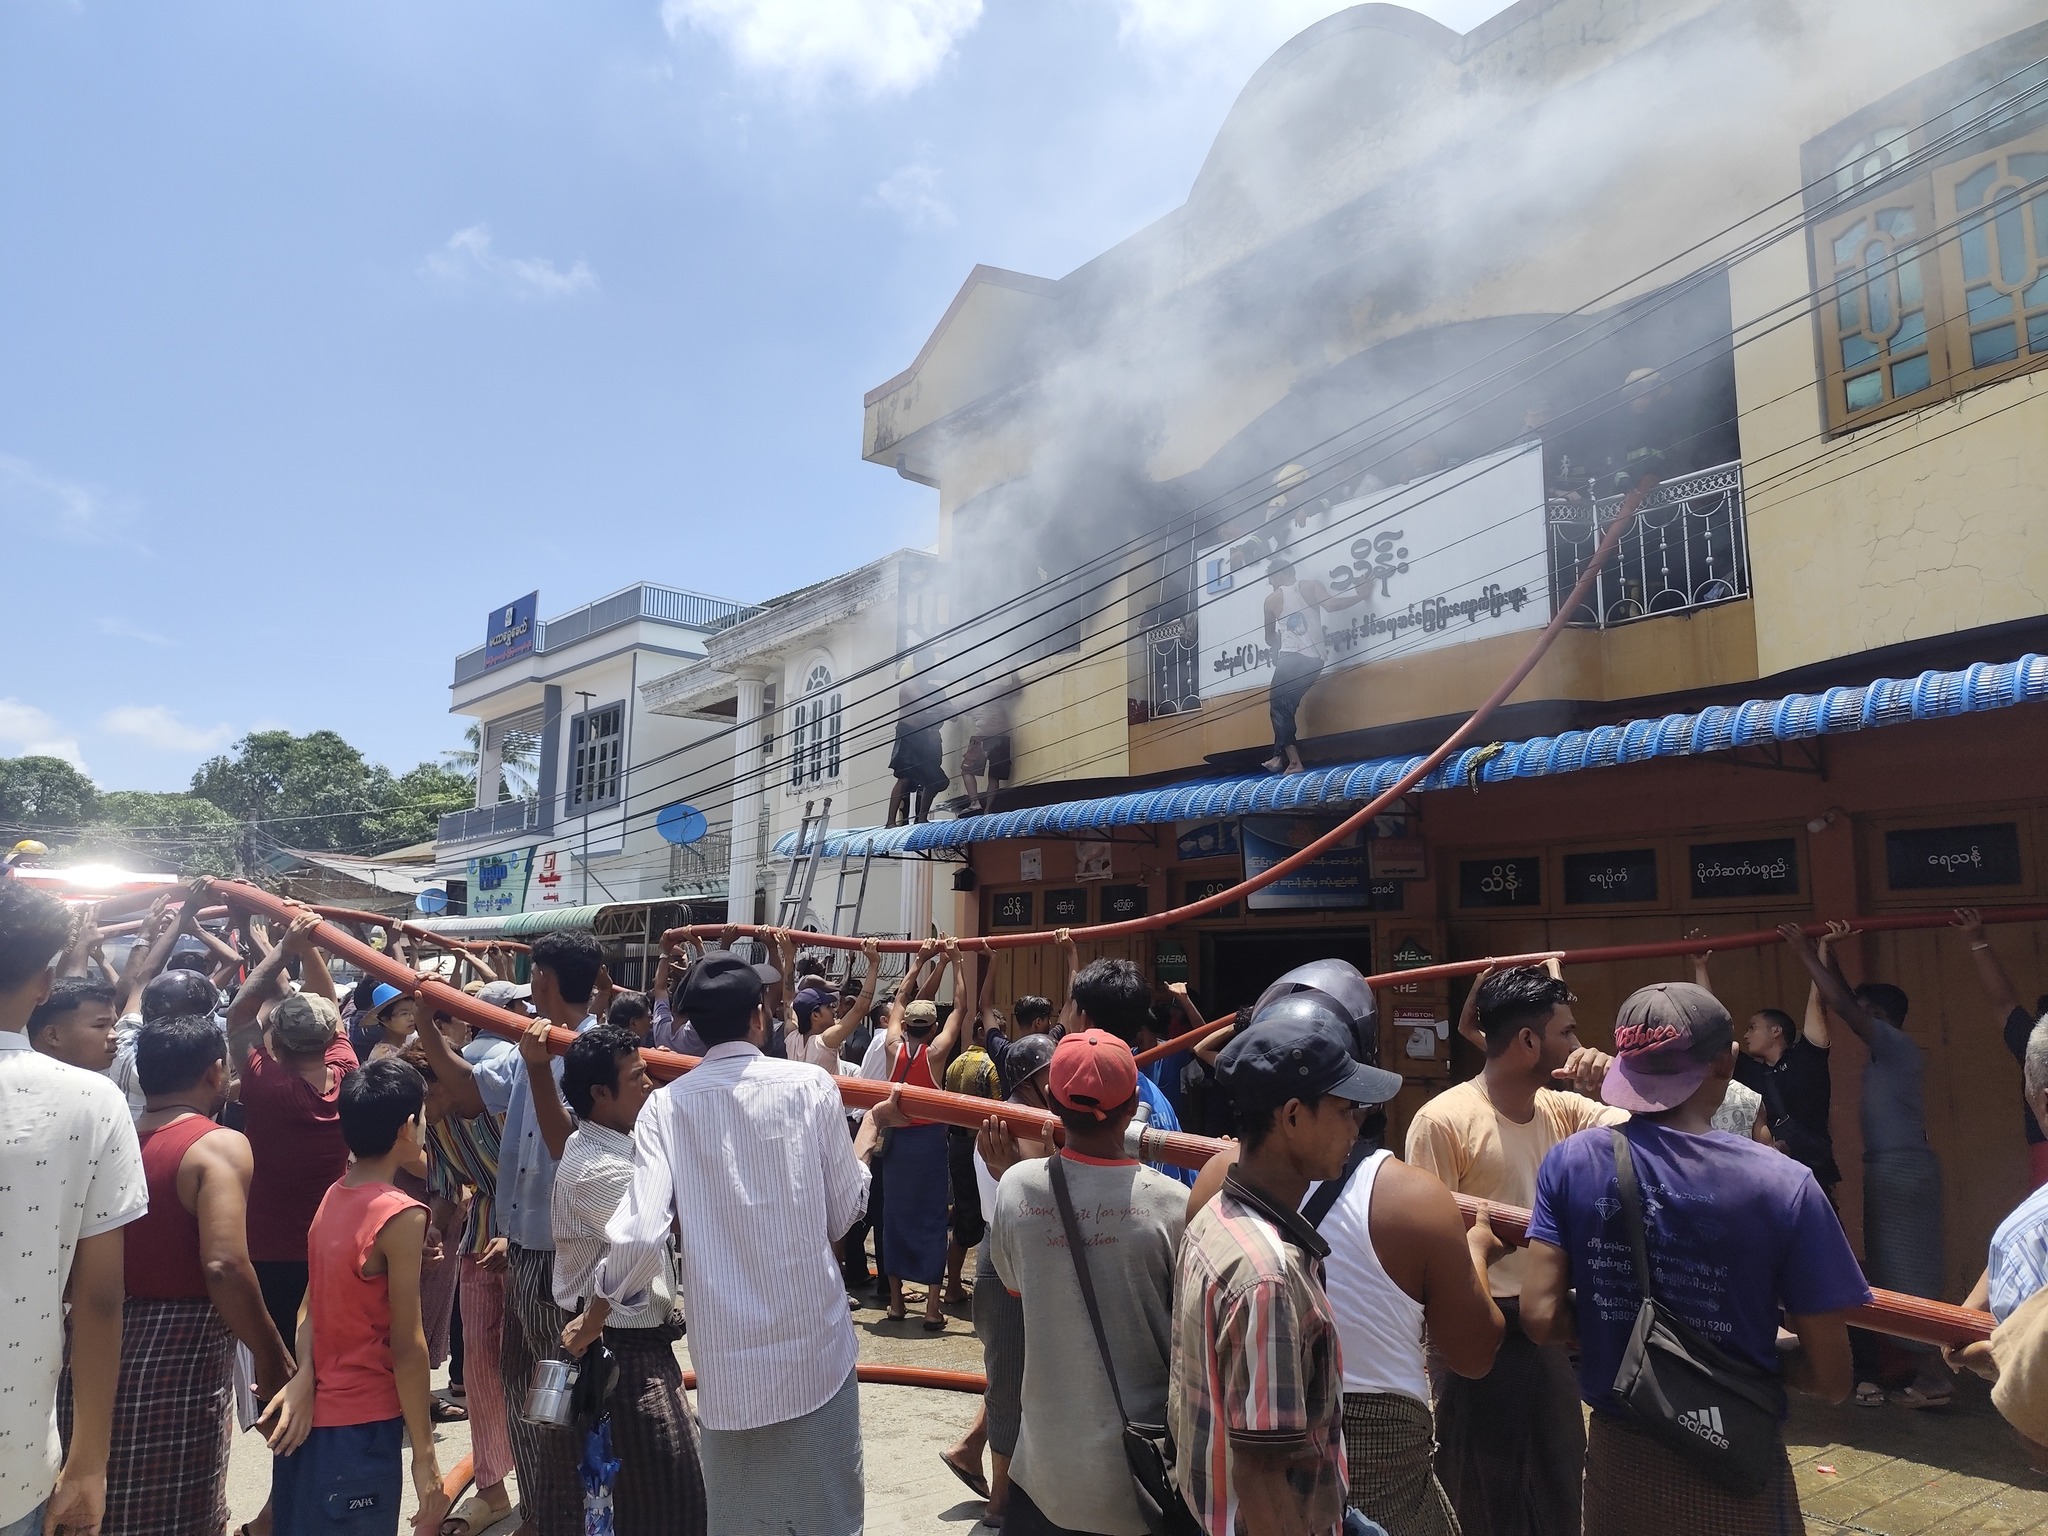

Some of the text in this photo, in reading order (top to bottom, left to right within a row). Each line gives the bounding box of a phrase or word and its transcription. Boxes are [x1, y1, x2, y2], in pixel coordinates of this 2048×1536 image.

[1927, 845, 1983, 873] ရေသန့်
[1480, 863, 1523, 900] သိန်း
[1588, 867, 1628, 890] ရေပိုက်
[1156, 954, 1188, 964] SHERA
[1095, 1203, 1115, 1225] for
[1677, 1414, 1730, 1450] adidas
[349, 1496, 375, 1510] ZARA
